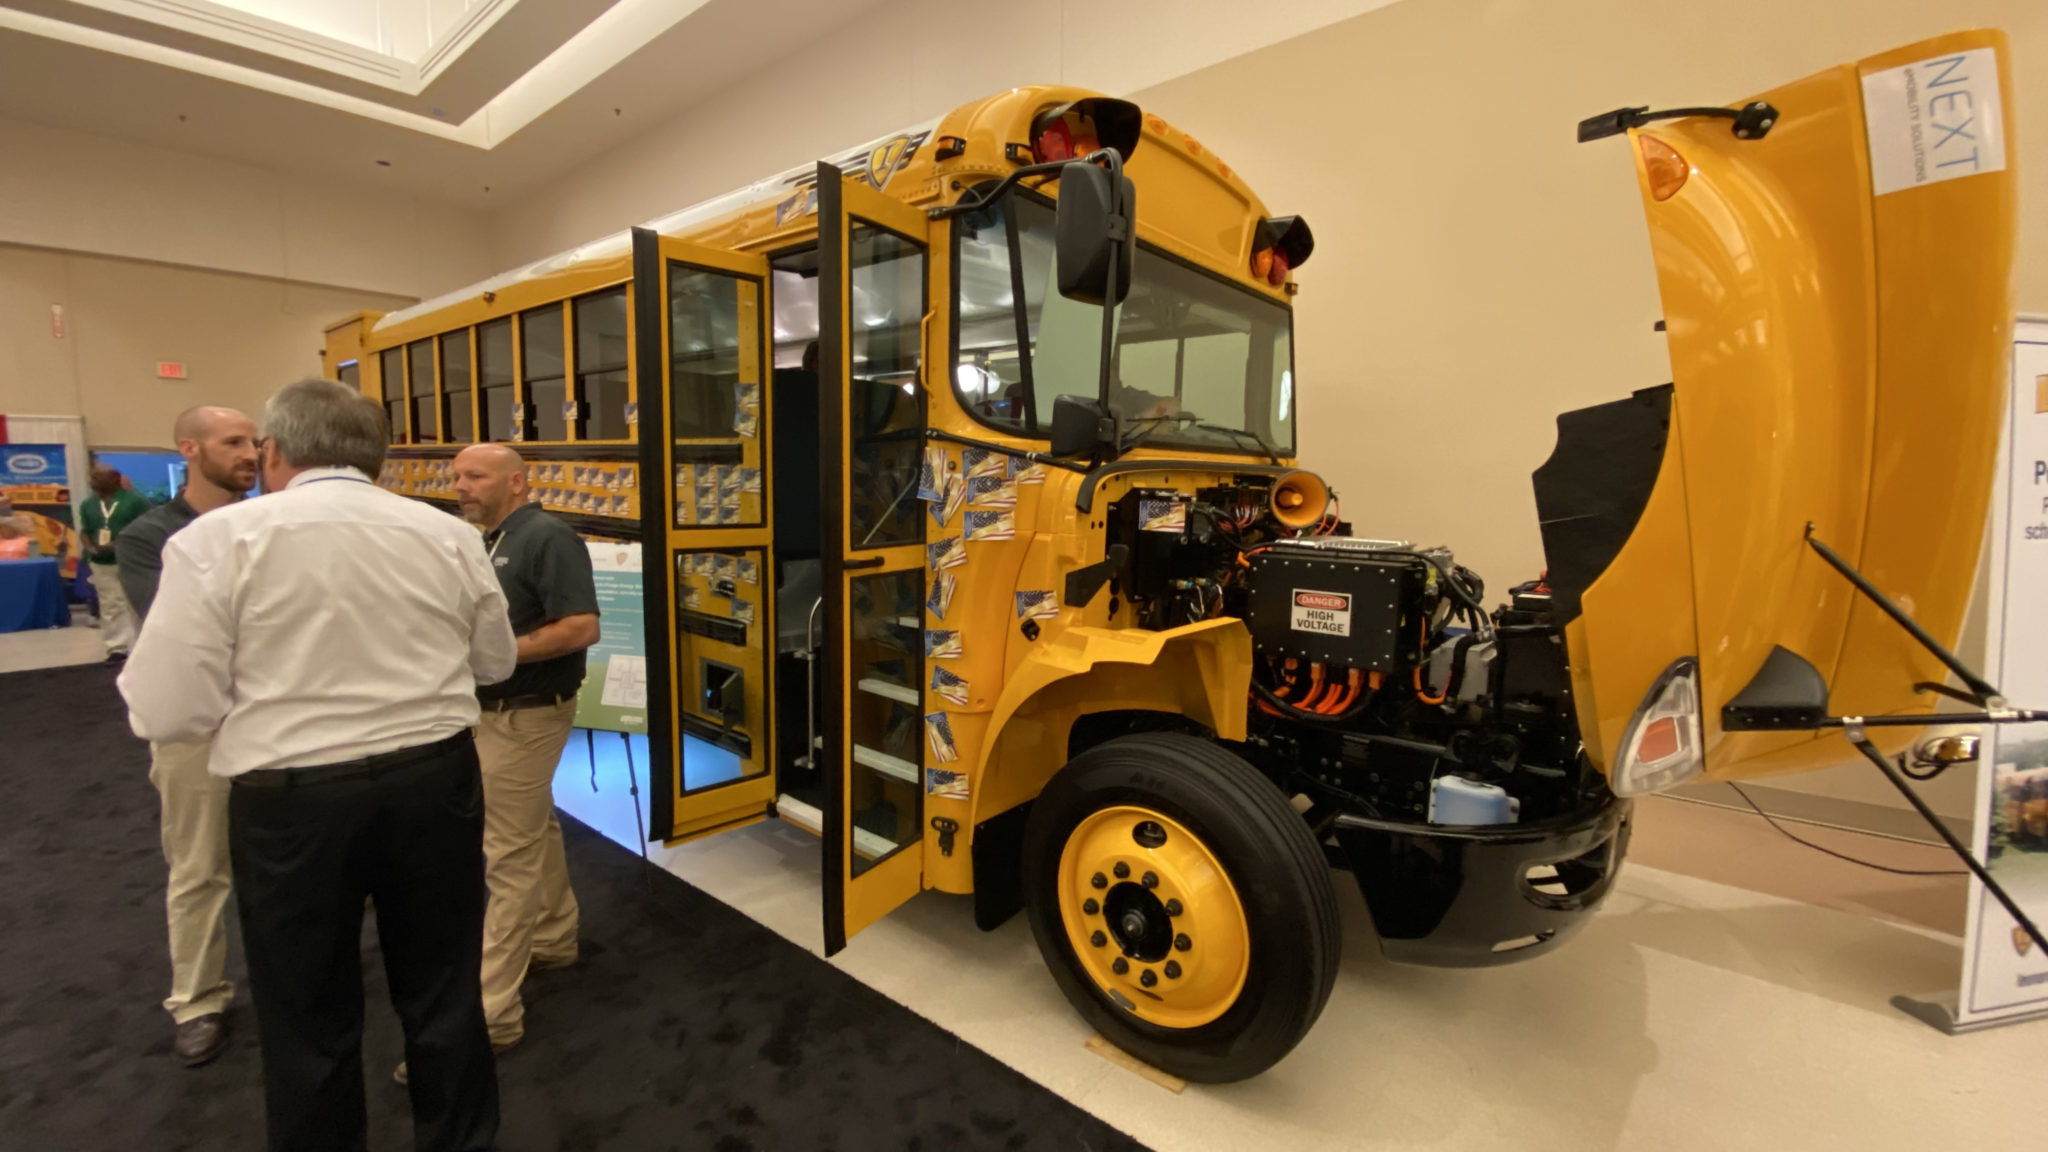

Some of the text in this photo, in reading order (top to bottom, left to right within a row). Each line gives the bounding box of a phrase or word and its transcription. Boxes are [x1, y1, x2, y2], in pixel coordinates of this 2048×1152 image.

[1924, 56, 1978, 170] NEXT
[1911, 123, 1927, 182] SOLUTIONS
[2034, 460, 2048, 485] P
[1302, 595, 1341, 606] DANGER
[1307, 610, 1334, 621] HIGH
[1297, 619, 1344, 632] VOLTAGE
